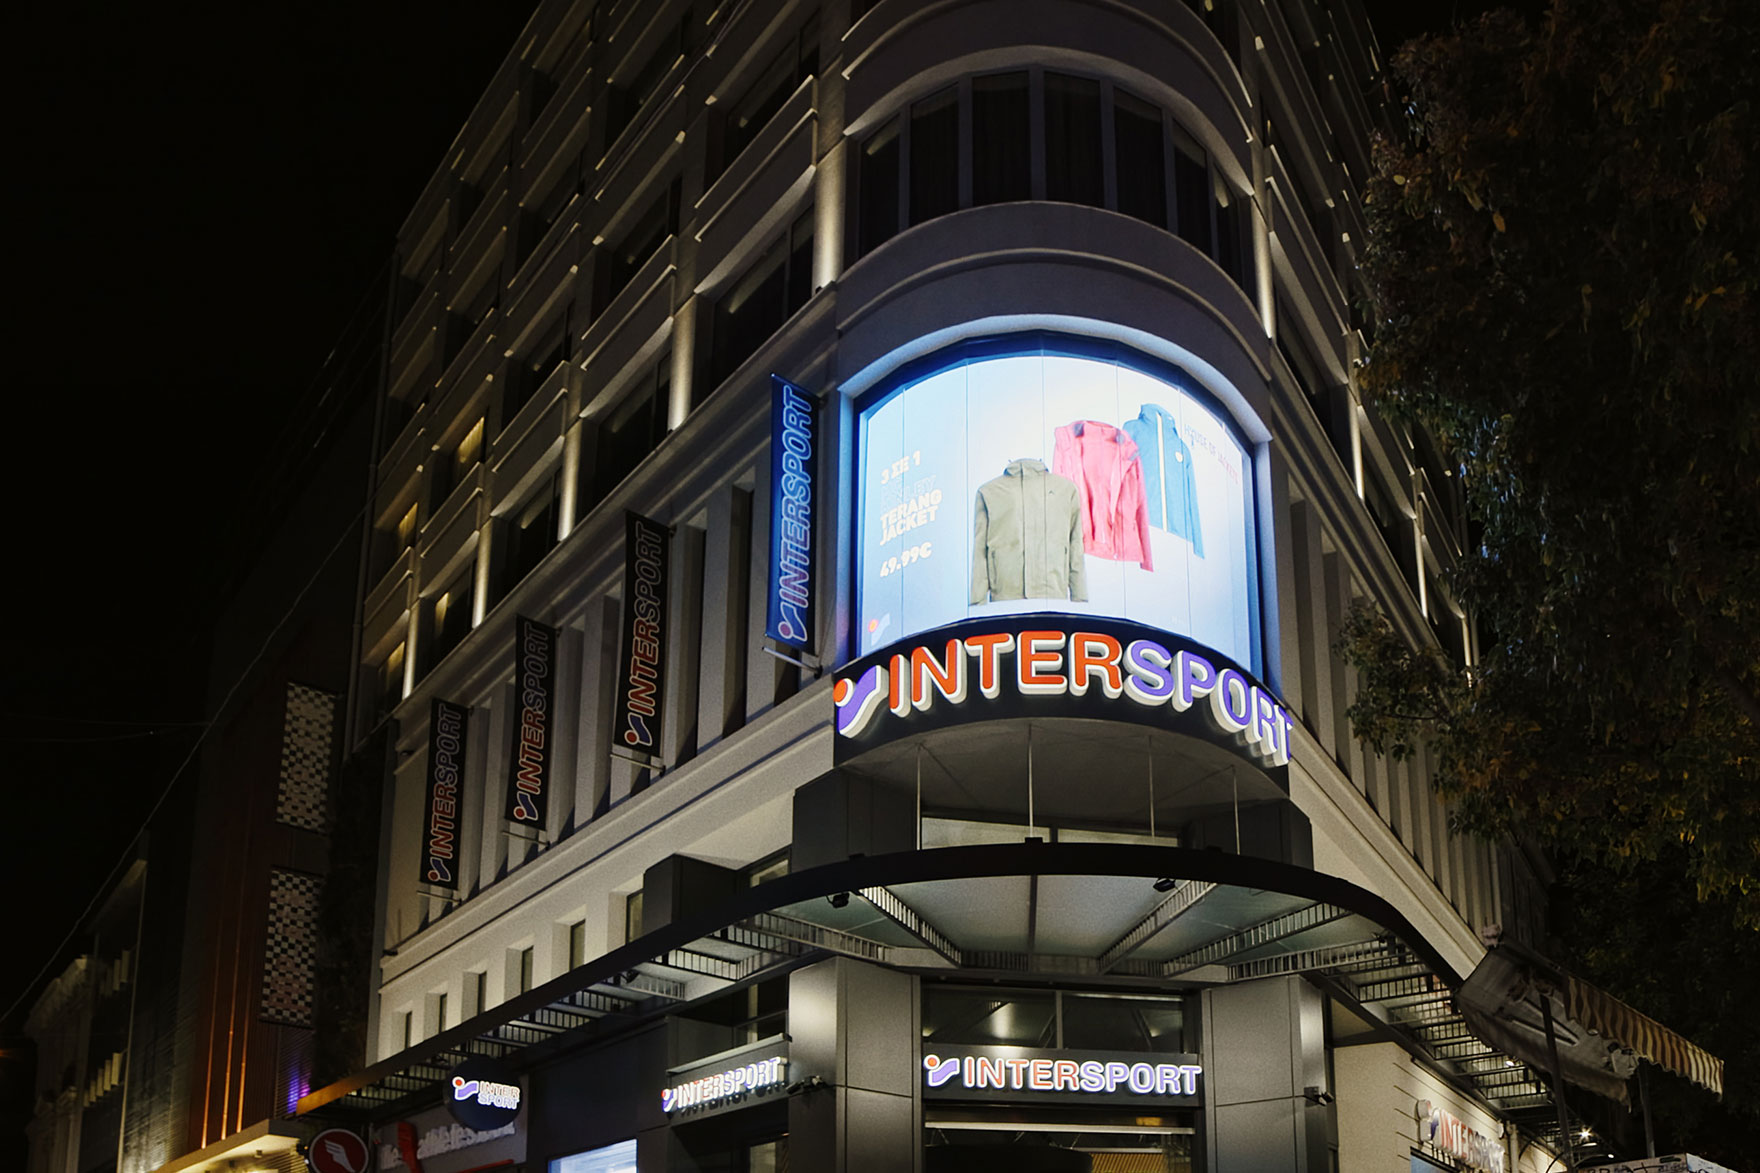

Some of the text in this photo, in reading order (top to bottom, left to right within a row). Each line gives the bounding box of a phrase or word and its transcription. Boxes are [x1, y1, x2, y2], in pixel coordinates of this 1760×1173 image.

[880, 469, 889, 485] 3
[912, 450, 921, 466] 1
[777, 384, 813, 609] INTERSPORT
[880, 505, 940, 547] JACKET
[627, 521, 665, 718] INTERSPORT
[516, 621, 553, 796] INTERSPORT
[888, 630, 1294, 768] INTERSPORT
[430, 703, 464, 858] INTERSPORT
[478, 1086, 520, 1110] SPORT
[480, 1081, 521, 1099] INTER
[677, 1056, 787, 1109] INTERSPORT
[963, 1055, 1203, 1095] INTERSPORT
